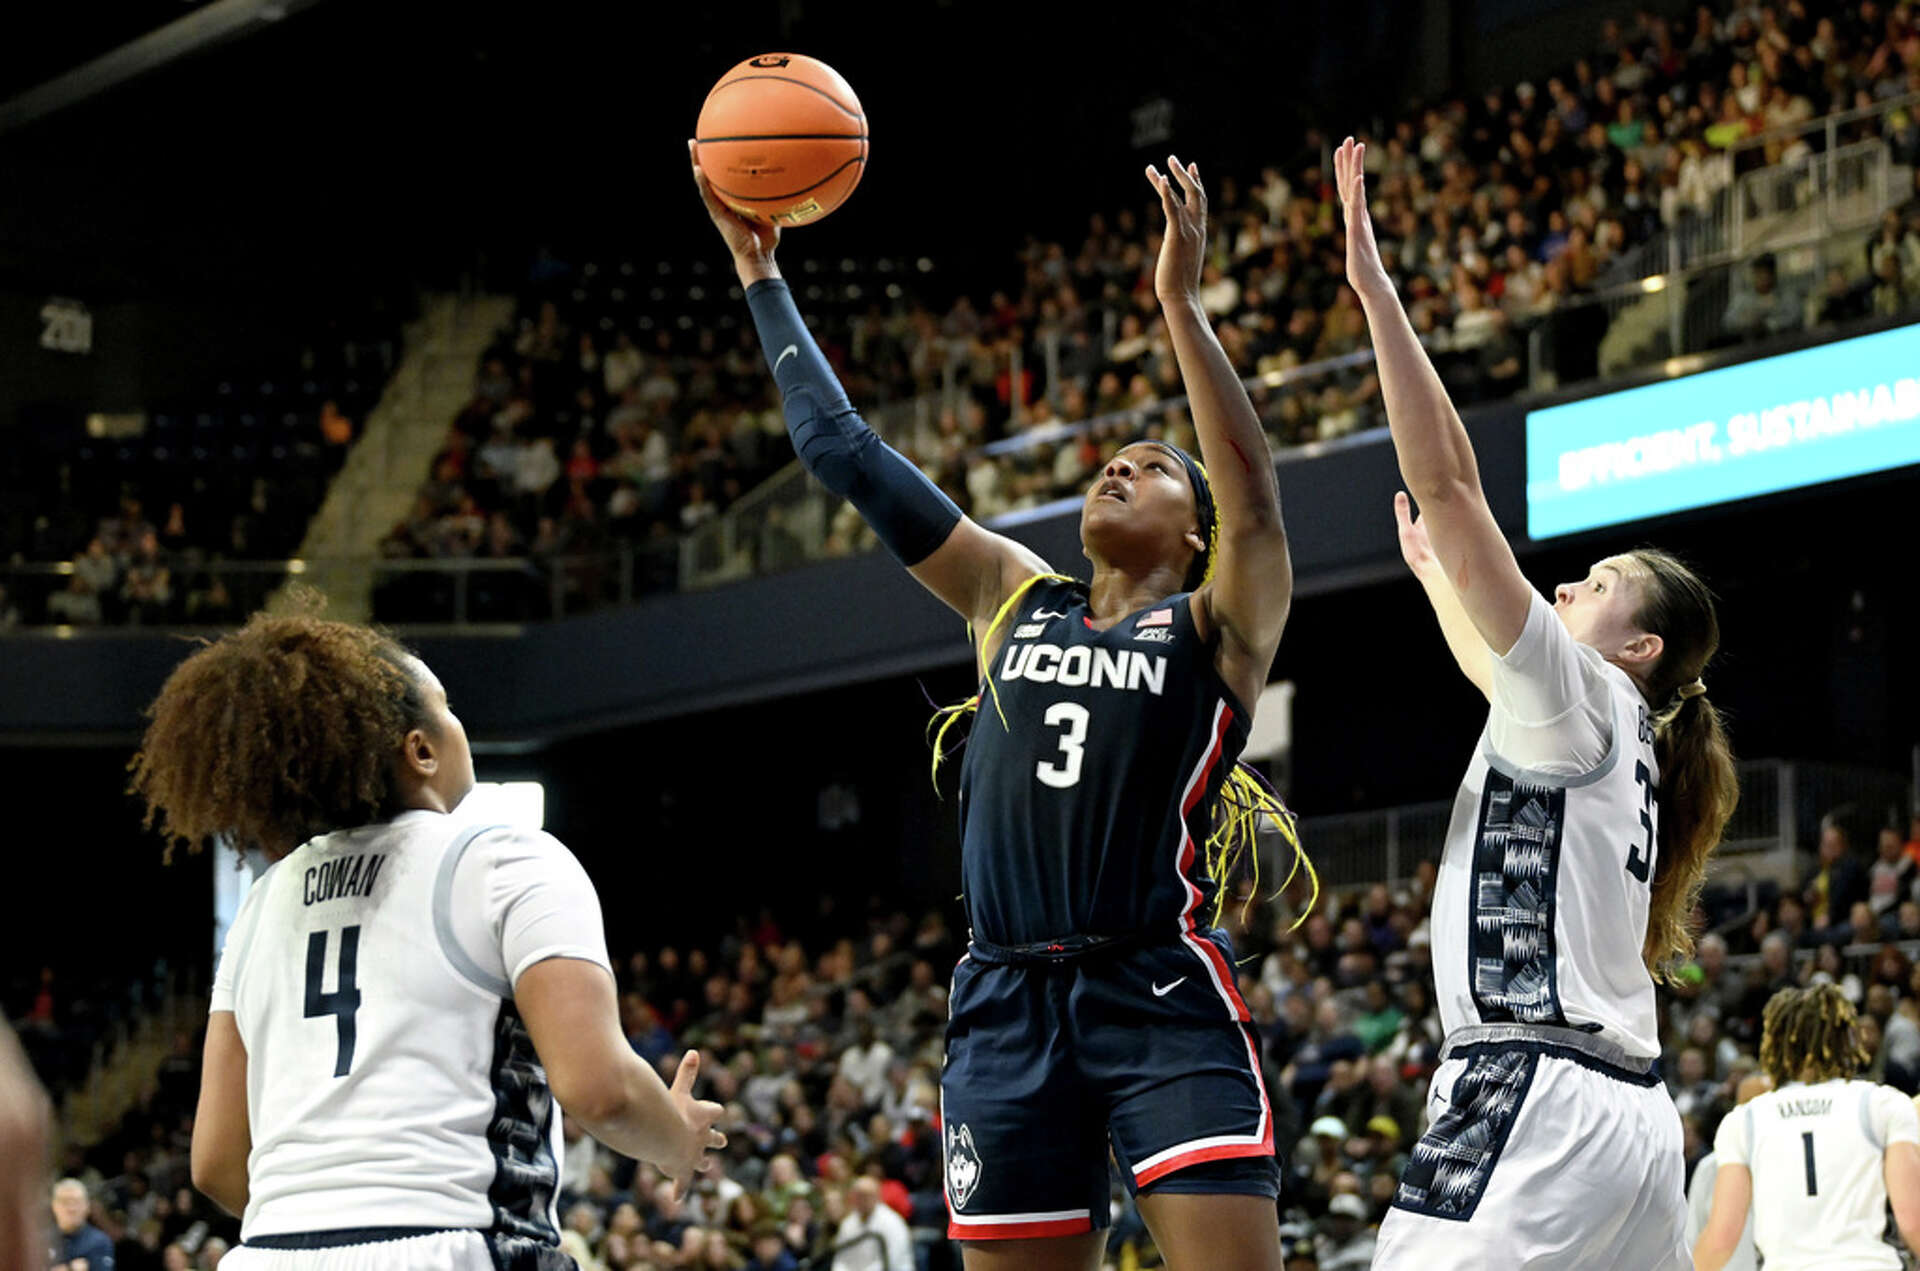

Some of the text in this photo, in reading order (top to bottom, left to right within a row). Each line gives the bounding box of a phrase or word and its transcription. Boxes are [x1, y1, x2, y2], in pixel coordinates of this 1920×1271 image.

[1001, 644, 1167, 696] UCONN
[1036, 702, 1090, 788] 3
[1625, 758, 1659, 884] 3
[304, 854, 386, 906] COWAN
[304, 924, 361, 1078] 4
[1801, 1131, 1818, 1197] 1
